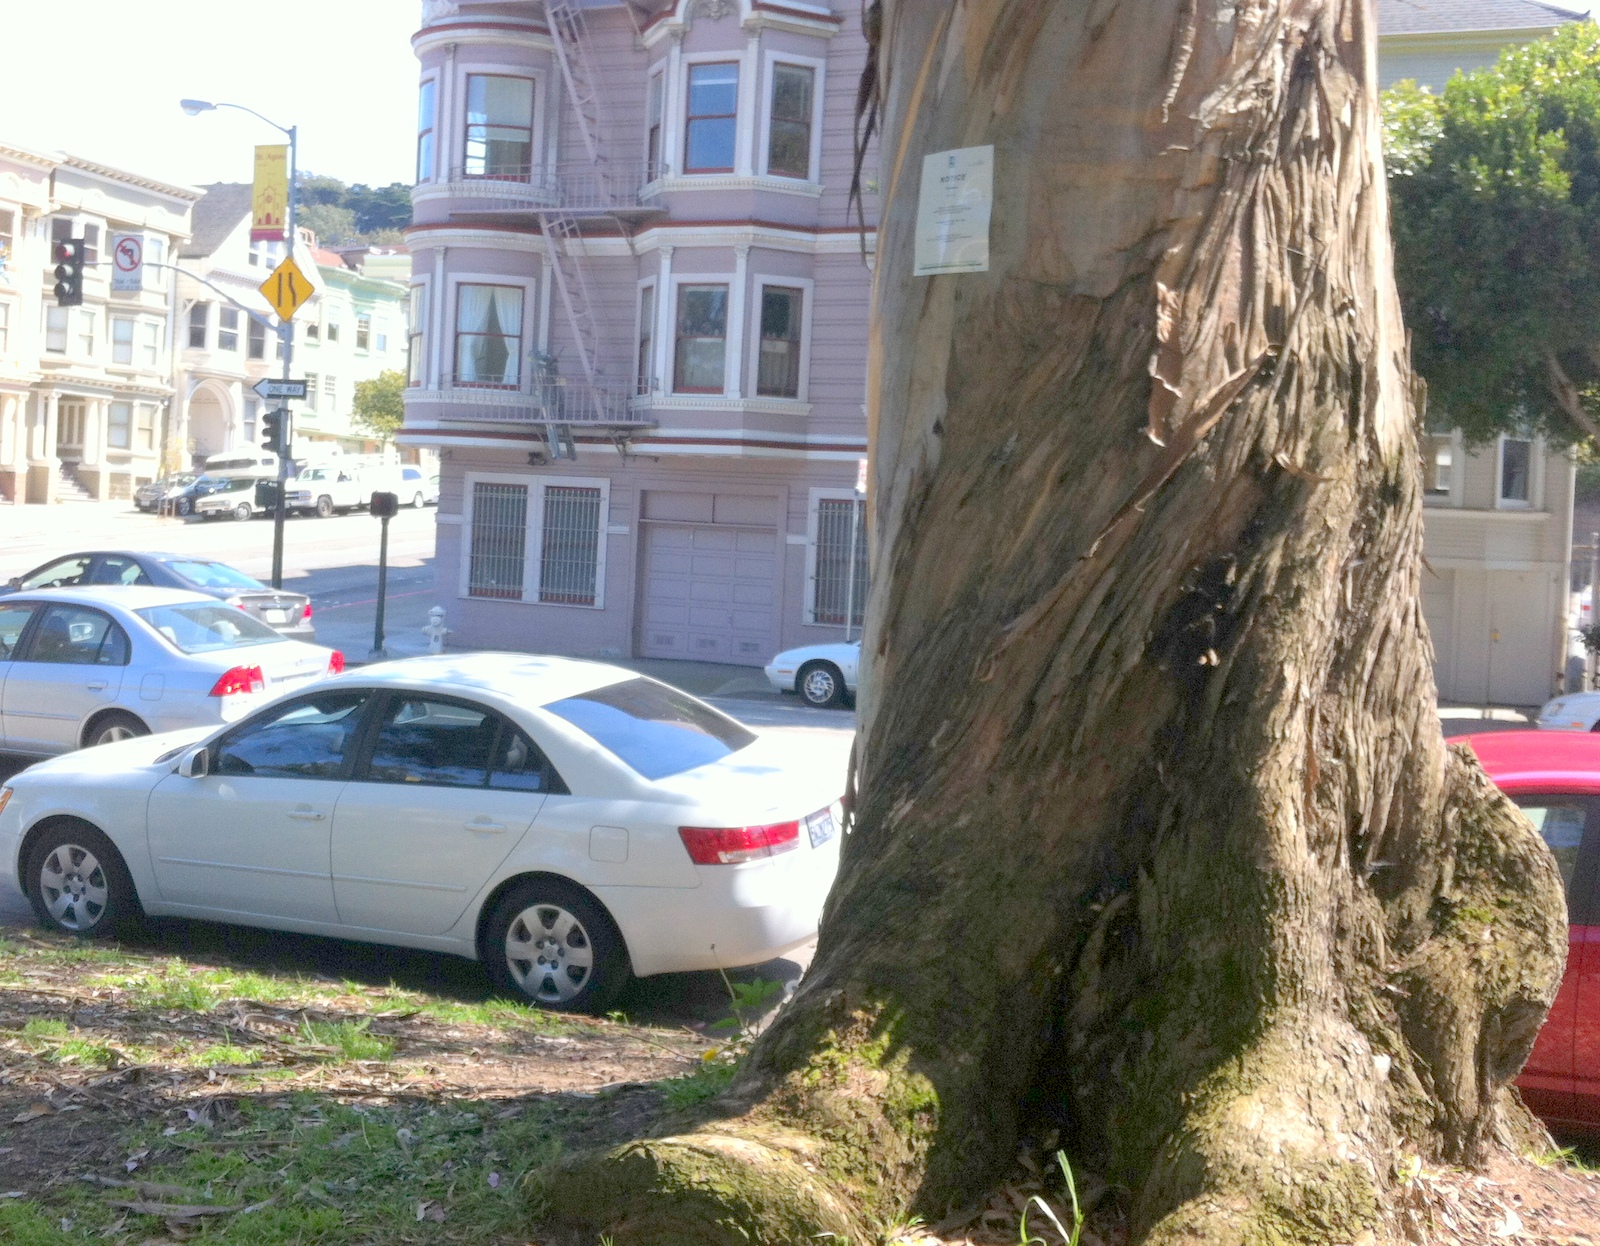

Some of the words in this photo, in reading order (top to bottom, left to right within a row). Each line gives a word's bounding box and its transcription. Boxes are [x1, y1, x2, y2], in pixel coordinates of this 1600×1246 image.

[940, 173, 967, 183] NOTICE
[268, 385, 283, 394] ONE
[286, 385, 302, 394] WAY
